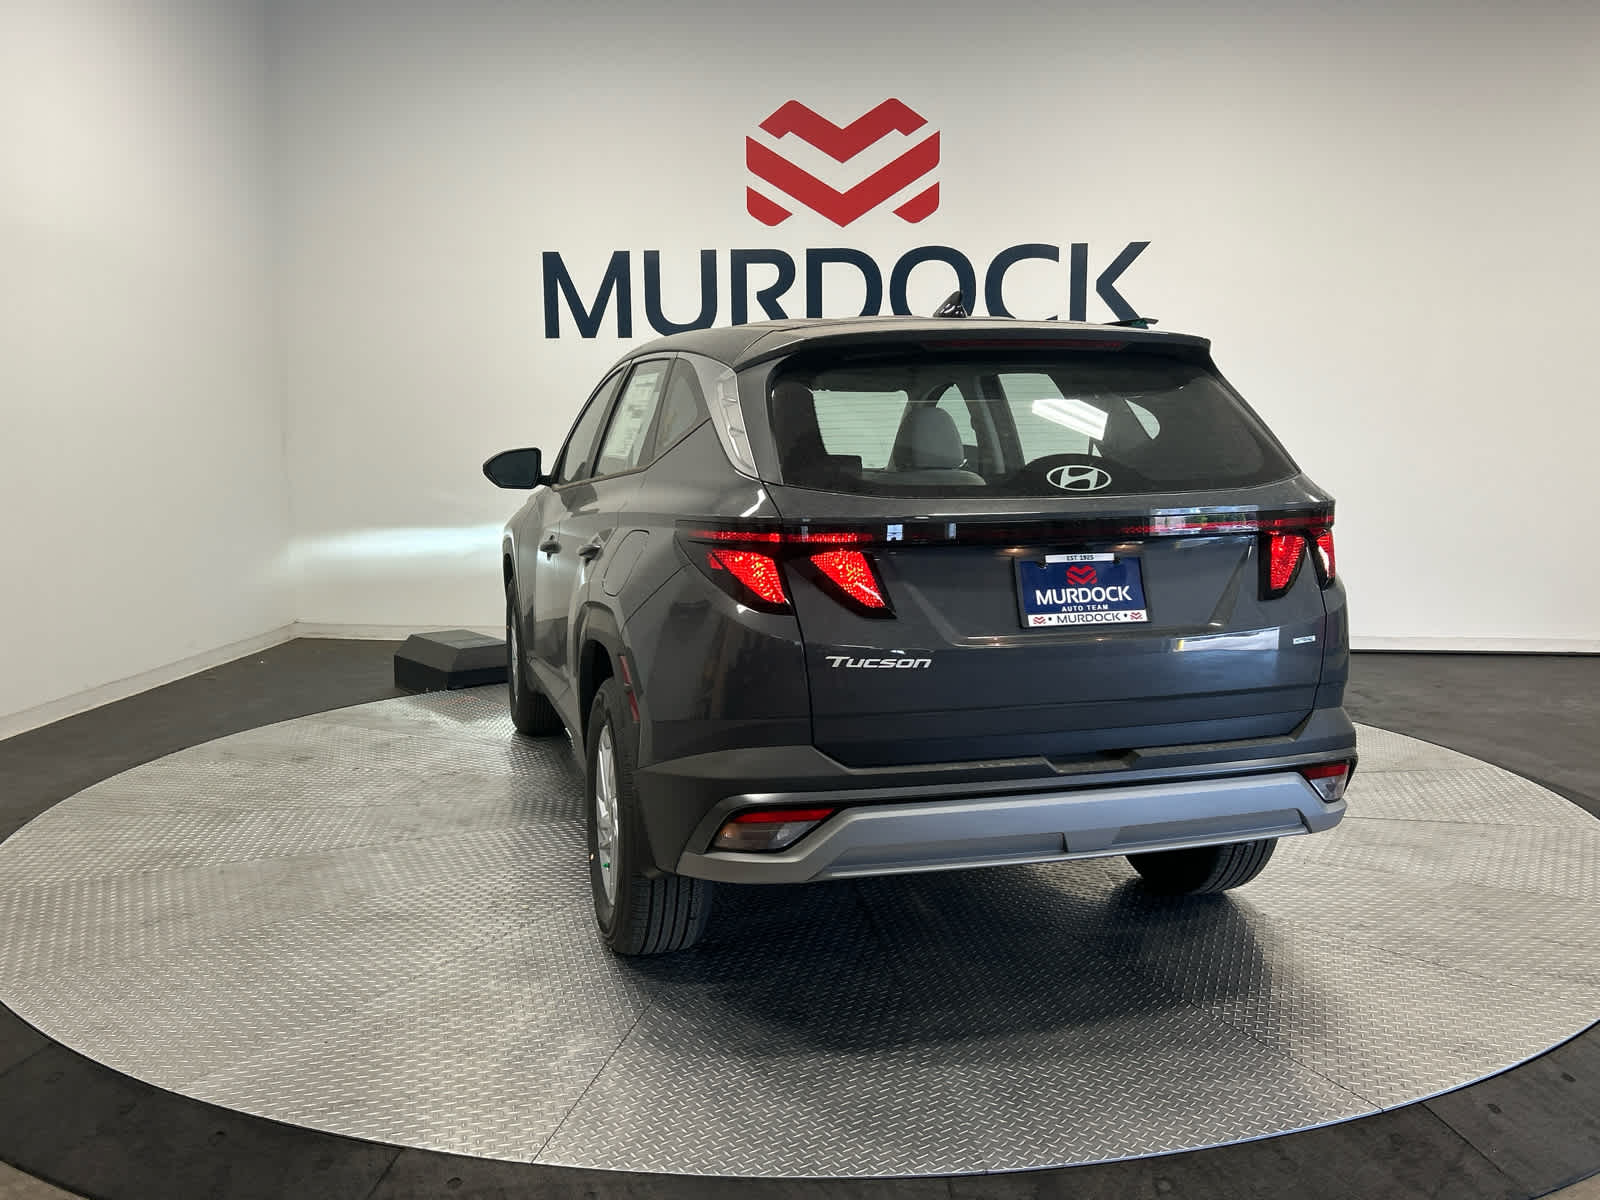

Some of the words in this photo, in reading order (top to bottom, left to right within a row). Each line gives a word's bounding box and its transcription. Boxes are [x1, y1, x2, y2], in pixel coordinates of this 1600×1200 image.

[542, 241, 1152, 339] MURDOCK
[1035, 585, 1132, 605] MURDOCK
[1087, 603, 1108, 611] TEAM
[1056, 612, 1120, 623] MURDOCK
